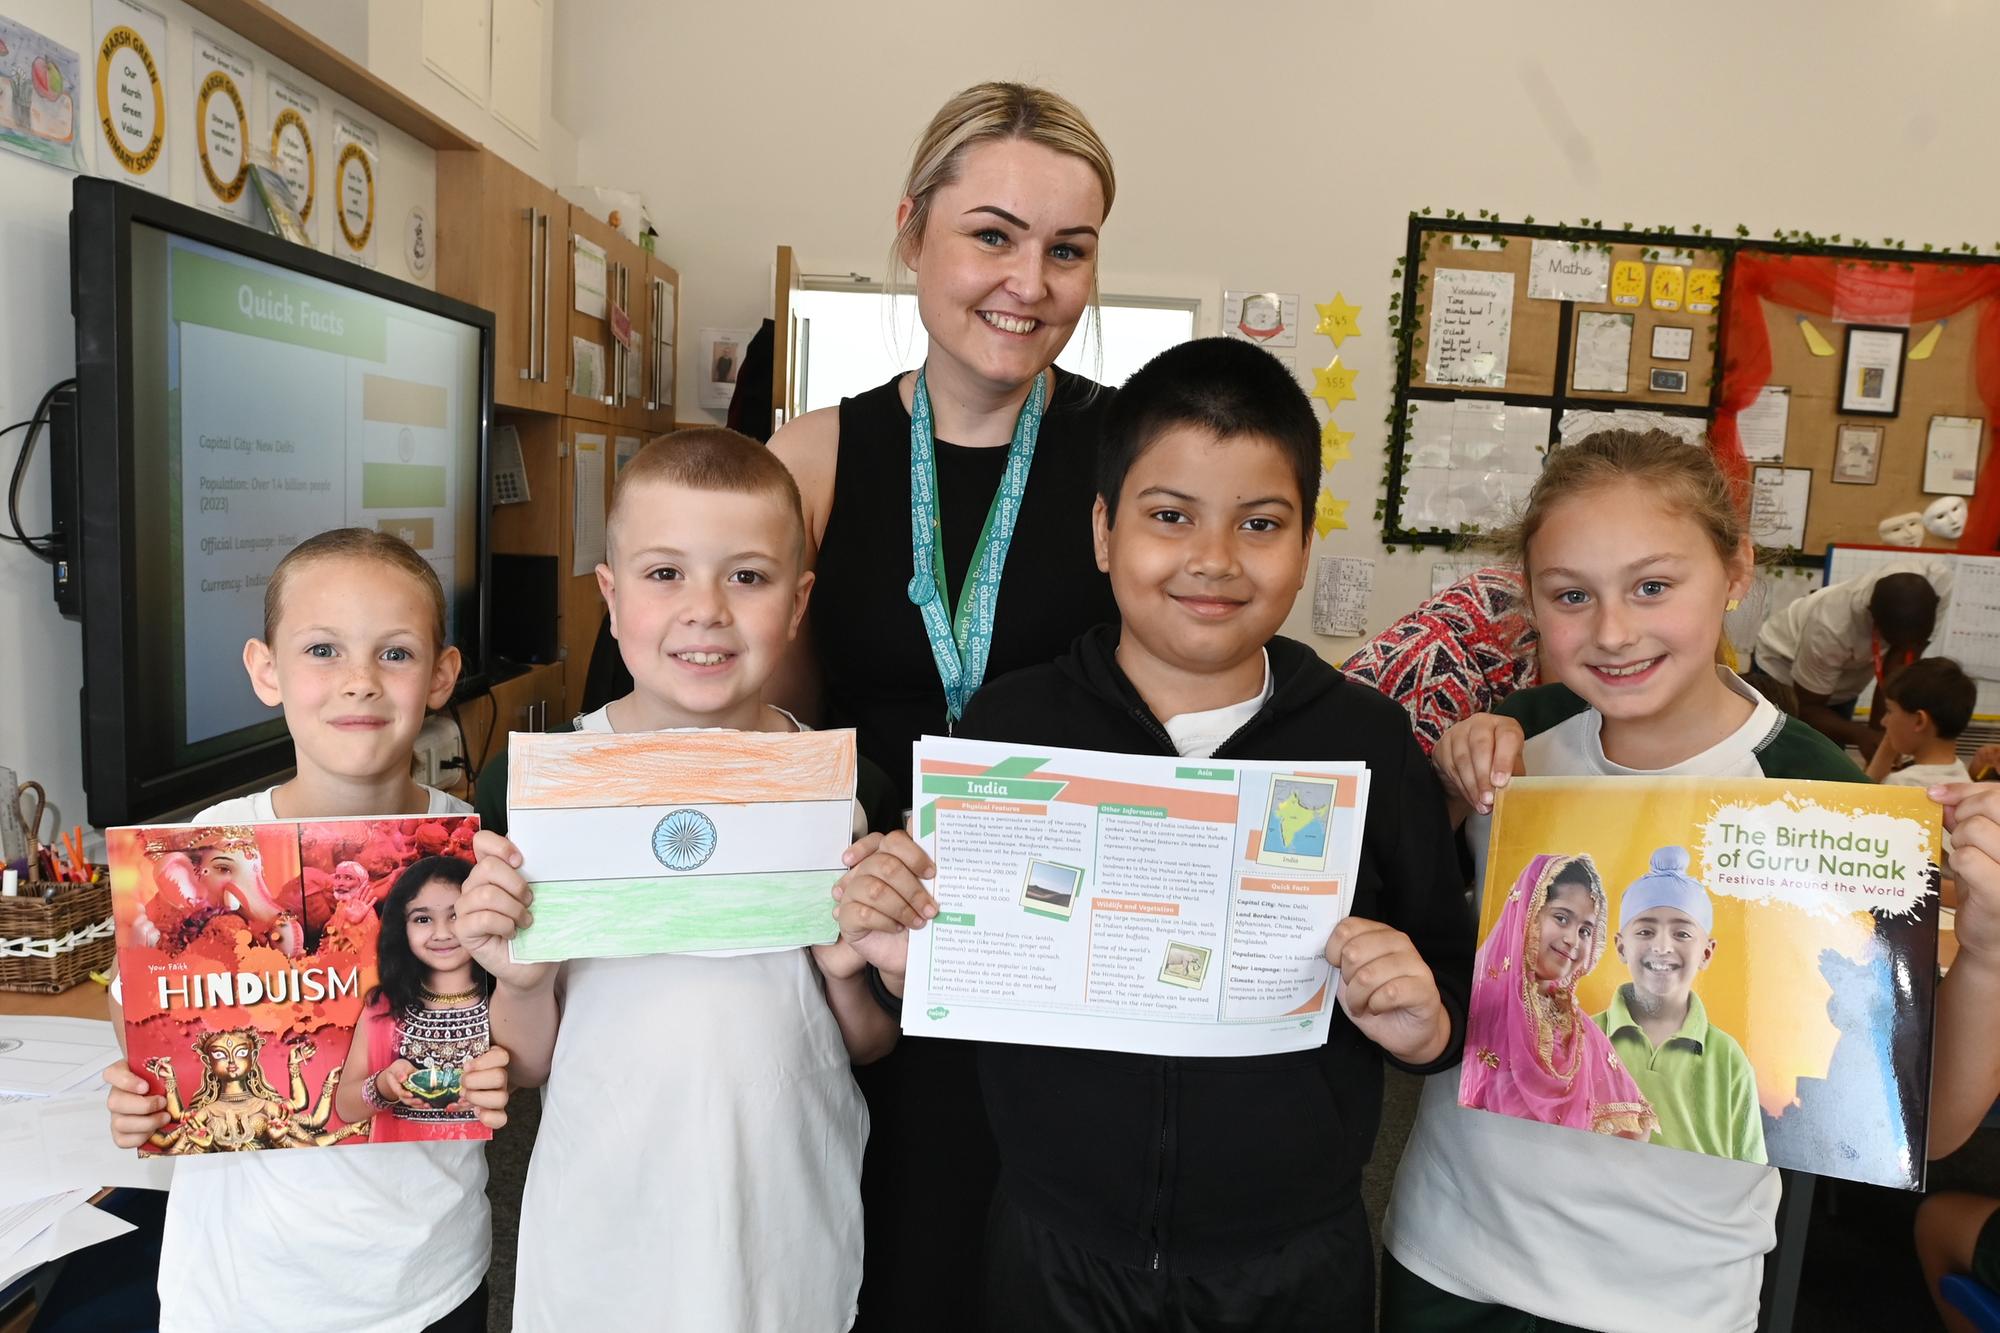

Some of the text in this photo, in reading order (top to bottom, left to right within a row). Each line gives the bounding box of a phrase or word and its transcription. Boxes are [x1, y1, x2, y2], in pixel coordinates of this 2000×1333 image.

[103, 31, 158, 84] MARSH GREEN
[124, 66, 137, 79] Our
[121, 84, 142, 100] Marsh
[122, 103, 142, 118] Green
[121, 120, 143, 138] Values
[103, 118, 161, 171] PRIMARY SCHOOL
[1549, 258, 1592, 277] Maths
[1447, 296, 1464, 305] Time
[1452, 287, 1496, 300] Vocabulary
[238, 284, 345, 337] Quick Facts
[1469, 307, 1483, 315] hand
[1459, 337, 1471, 347] past
[1460, 348, 1471, 356] past
[199, 434, 231, 452] Capital
[256, 440, 273, 452] New
[275, 441, 295, 453] Delhi
[916, 420, 929, 461] education
[1022, 414, 1033, 455] education
[916, 462, 930, 503] education
[1011, 455, 1022, 497] education
[200, 476, 249, 493] Population:
[252, 477, 270, 491] Over
[285, 478, 307, 491] billion
[310, 481, 331, 496] people
[200, 497, 229, 514] (2023)
[917, 504, 931, 544] education
[1000, 497, 1012, 539] education
[201, 537, 232, 555] Official
[989, 540, 1001, 583] education
[980, 585, 992, 635] education
[957, 616, 971, 650] Marsh
[935, 638, 961, 688] education
[972, 636, 982, 688] education
[1197, 769, 1213, 777] Asia
[967, 781, 1009, 796] India
[962, 802, 1020, 813] Physical Features
[1101, 805, 1164, 818] Other Information
[1719, 823, 1889, 858] The Birthday
[1717, 849, 1906, 881] of Guru Nanak
[1271, 882, 1310, 892] Quick Facts
[1718, 873, 1906, 897] Festivals Around the World
[1096, 902, 1122, 911] Wildlife
[1137, 904, 1174, 914] Vegetation
[1237, 899, 1259, 907] Capital
[946, 915, 961, 923] Food
[1231, 963, 1248, 971] Major
[158, 966, 359, 1009] HINDUISM
